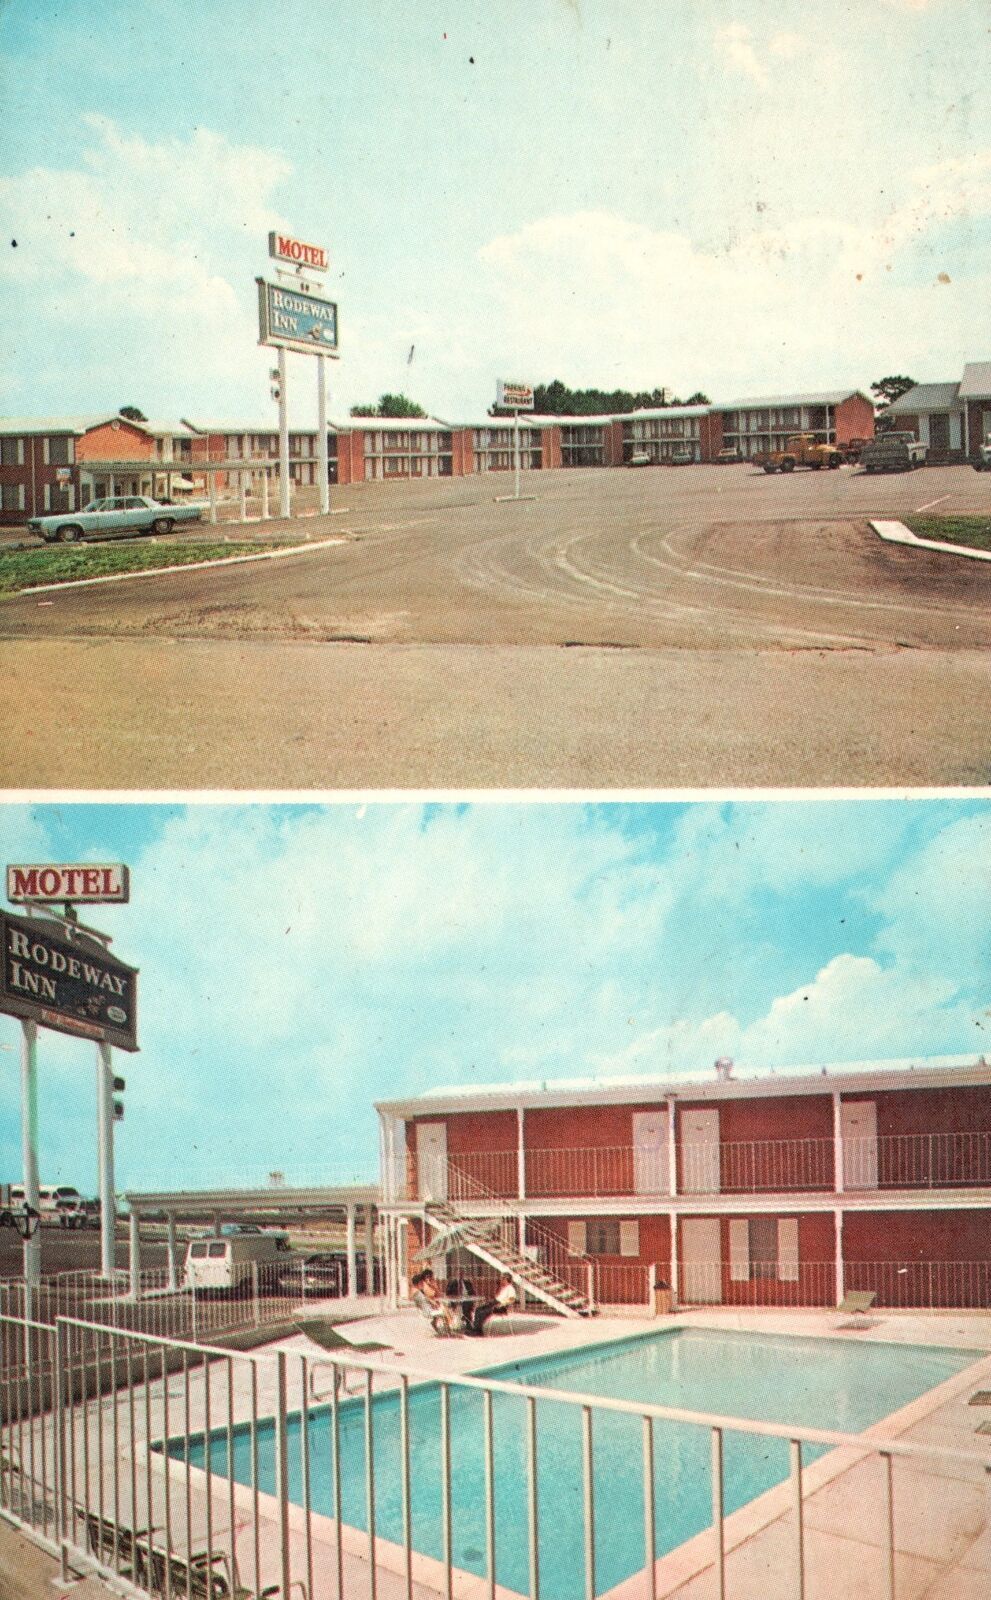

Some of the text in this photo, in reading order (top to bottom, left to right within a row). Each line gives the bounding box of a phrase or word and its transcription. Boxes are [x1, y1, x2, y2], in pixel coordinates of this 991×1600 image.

[278, 236, 328, 268] MOTEL
[273, 288, 333, 321] RODEWAY
[273, 311, 298, 332] INN
[12, 868, 120, 896] MOTEL
[9, 928, 127, 996] RODEWAY
[10, 959, 57, 1000] INN
